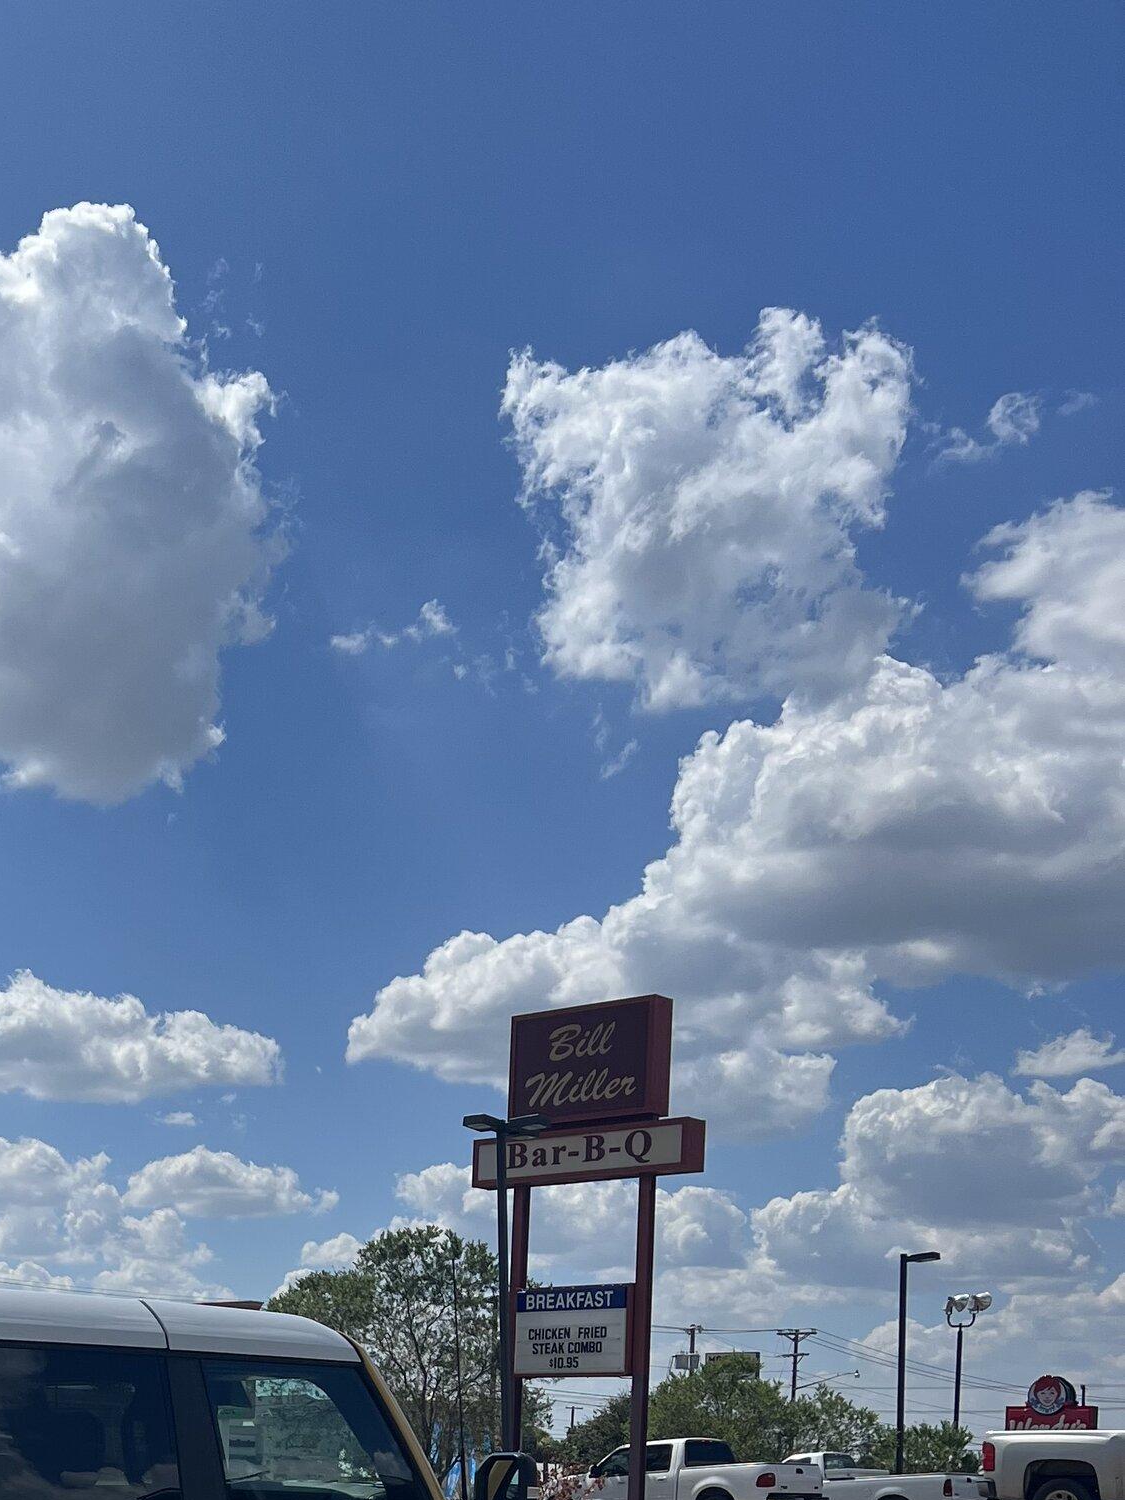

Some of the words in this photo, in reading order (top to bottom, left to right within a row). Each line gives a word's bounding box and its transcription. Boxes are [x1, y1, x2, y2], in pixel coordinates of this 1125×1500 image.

[548, 1021, 616, 1062] Bill
[524, 1067, 638, 1108] Miller
[506, 1129, 653, 1170] Bar-B-Q
[525, 1290, 614, 1310] BREAKFAST
[528, 1327, 571, 1340] CHICKEN
[578, 1326, 607, 1339] FRIED
[532, 1342, 565, 1355] STEAK
[567, 1341, 603, 1354] COMBO
[548, 1356, 579, 1369] $10.95
